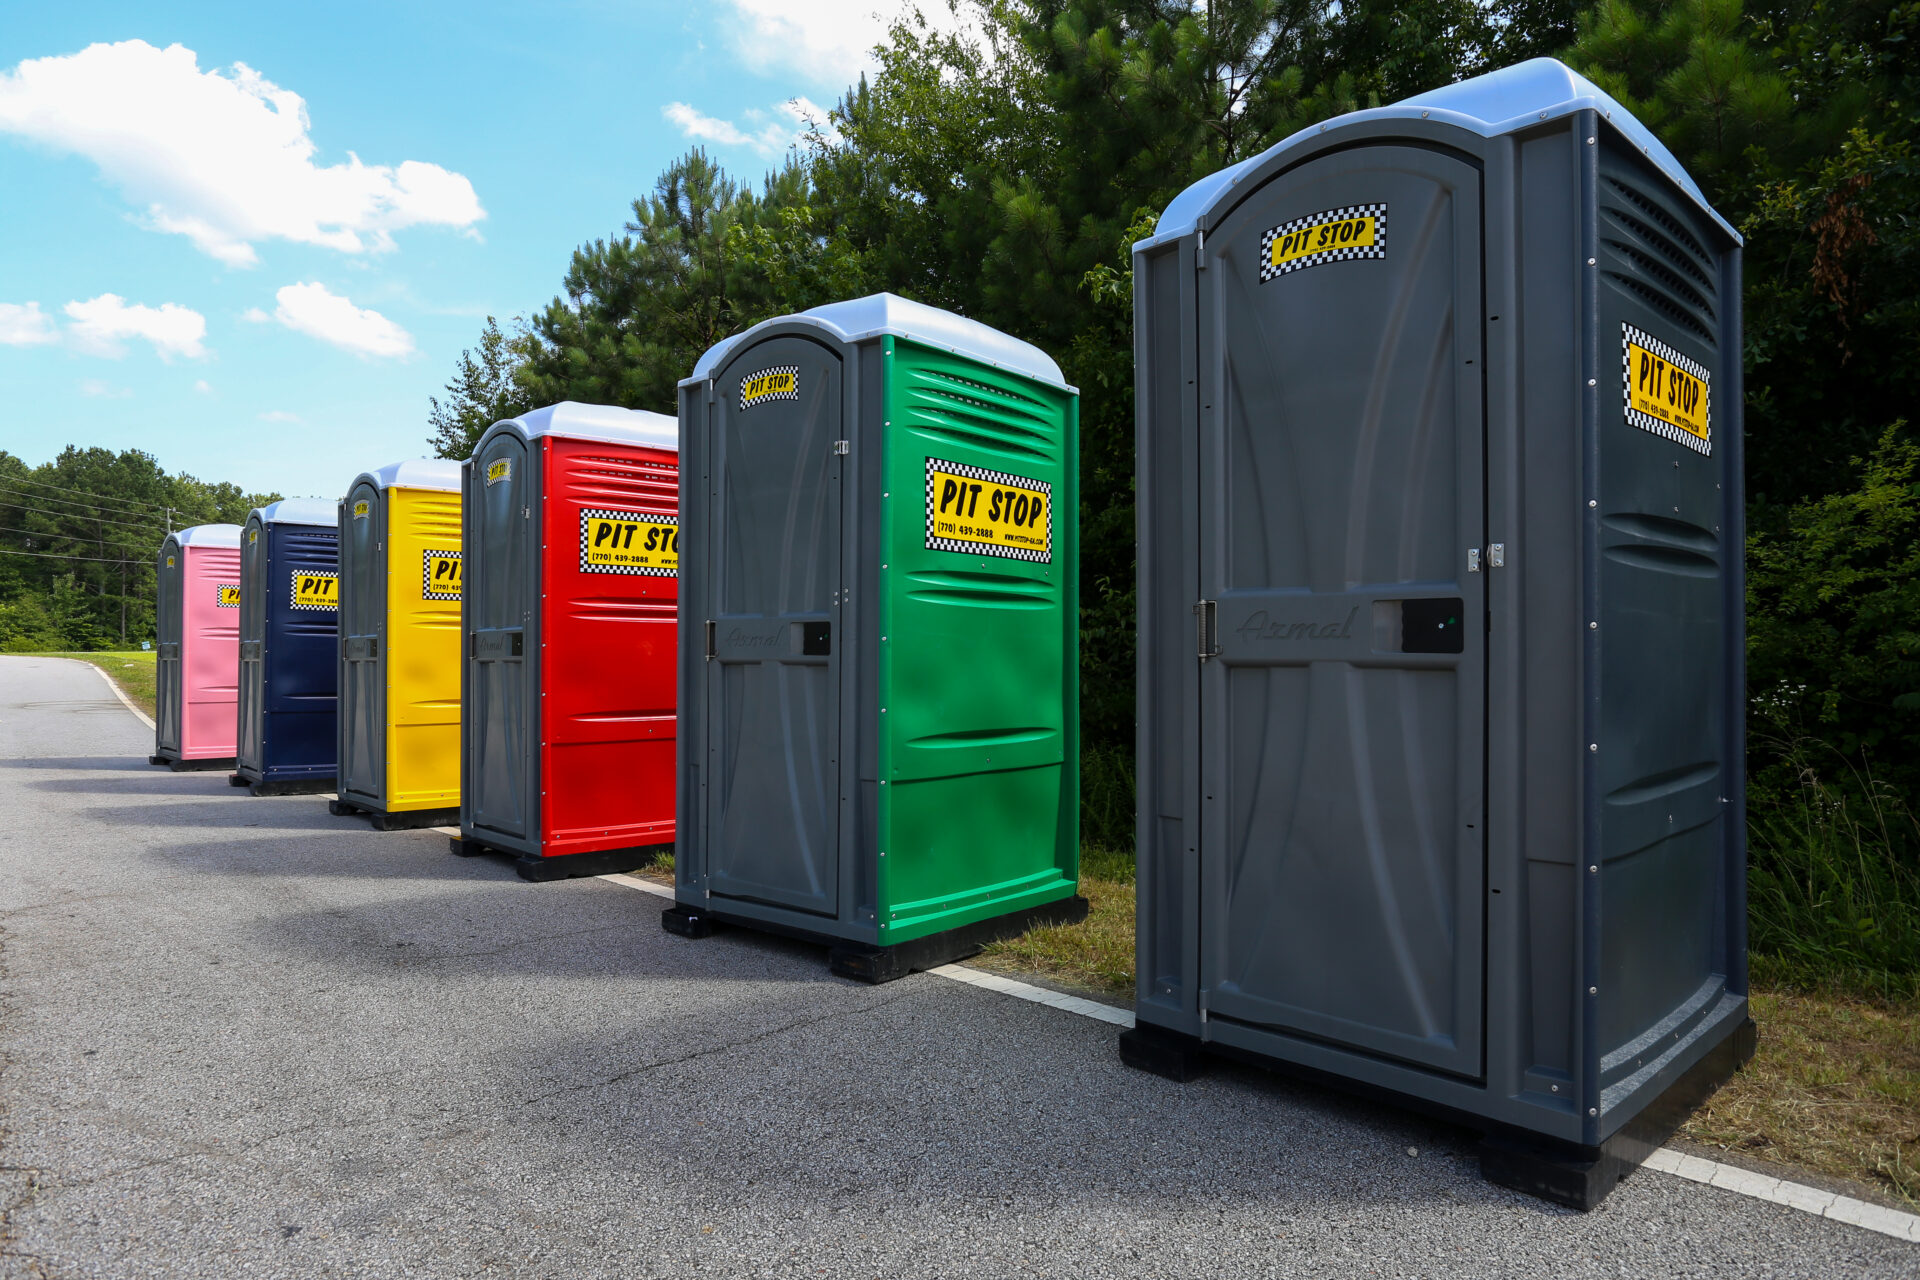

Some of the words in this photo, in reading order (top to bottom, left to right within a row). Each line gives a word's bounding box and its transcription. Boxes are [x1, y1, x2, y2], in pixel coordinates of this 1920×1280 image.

[1280, 229, 1312, 257] PIT
[1317, 220, 1366, 246] STOP
[750, 379, 765, 395] PIT
[768, 375, 789, 389] STOP
[1639, 352, 1664, 400] PIT
[1668, 368, 1698, 417] STOP
[940, 479, 982, 518] PIT
[988, 489, 1042, 528] STOP
[594, 522, 638, 549] PIT
[938, 521, 956, 535] (770)
[959, 526, 993, 539] 439-2888
[592, 553, 611, 562] (770)
[615, 555, 648, 563] 439-2888
[435, 560, 462, 580] PI
[301, 578, 333, 595] PIT
[433, 583, 449, 591] (770)
[1236, 606, 1359, 641] Armal
